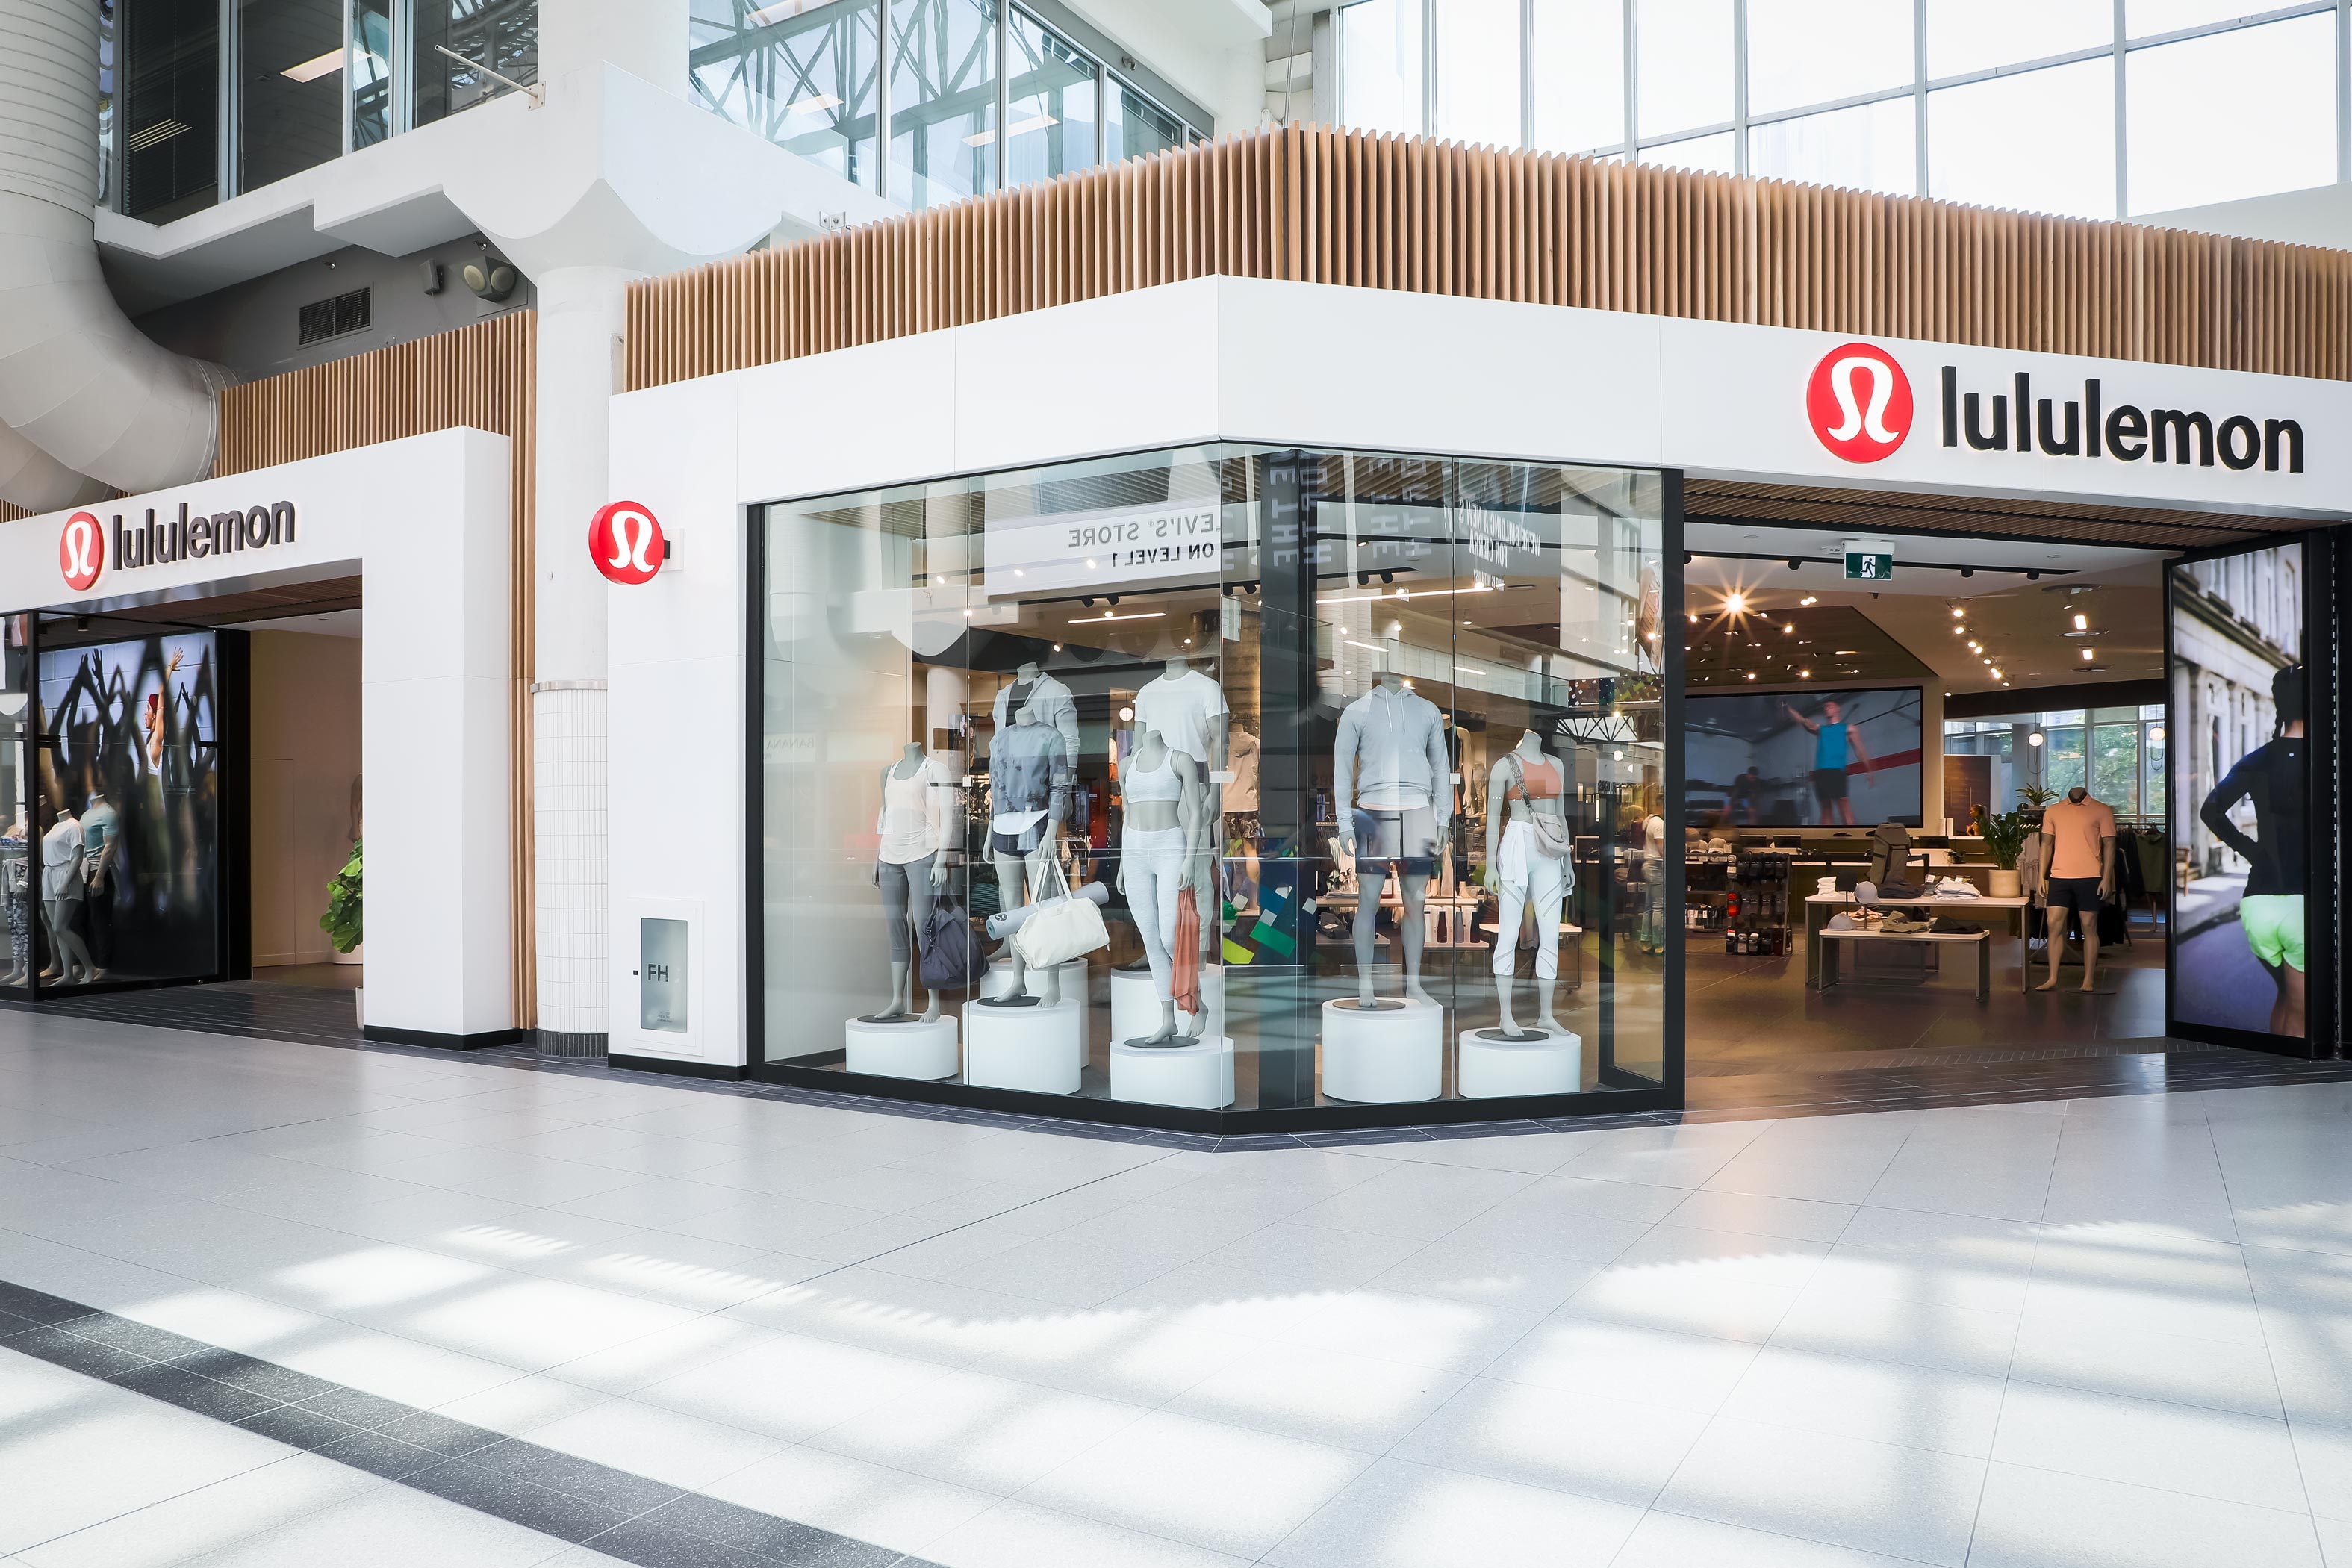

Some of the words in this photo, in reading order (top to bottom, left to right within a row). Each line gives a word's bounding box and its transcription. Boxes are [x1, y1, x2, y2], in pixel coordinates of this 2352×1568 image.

[1941, 365, 2304, 474] lululemon
[113, 500, 296, 570] lululemon
[647, 963, 669, 983] FH
